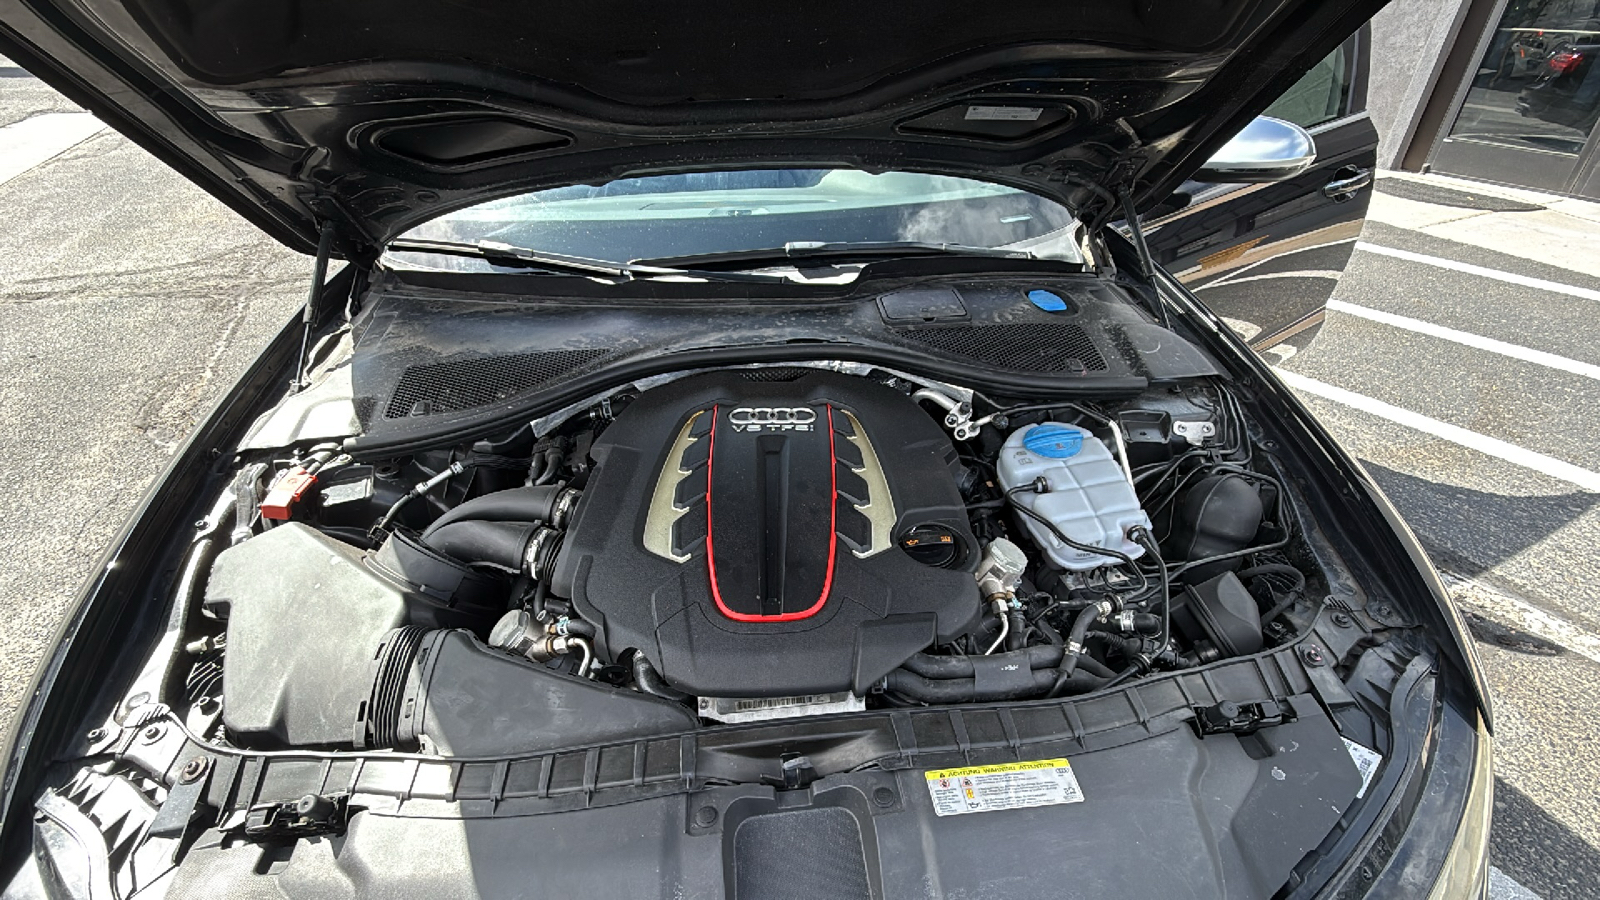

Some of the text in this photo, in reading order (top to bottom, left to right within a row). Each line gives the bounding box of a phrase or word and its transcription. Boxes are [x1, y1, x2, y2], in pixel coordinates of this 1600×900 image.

[948, 762, 1055, 777] ACHTUNG WARNING ATTENTION
